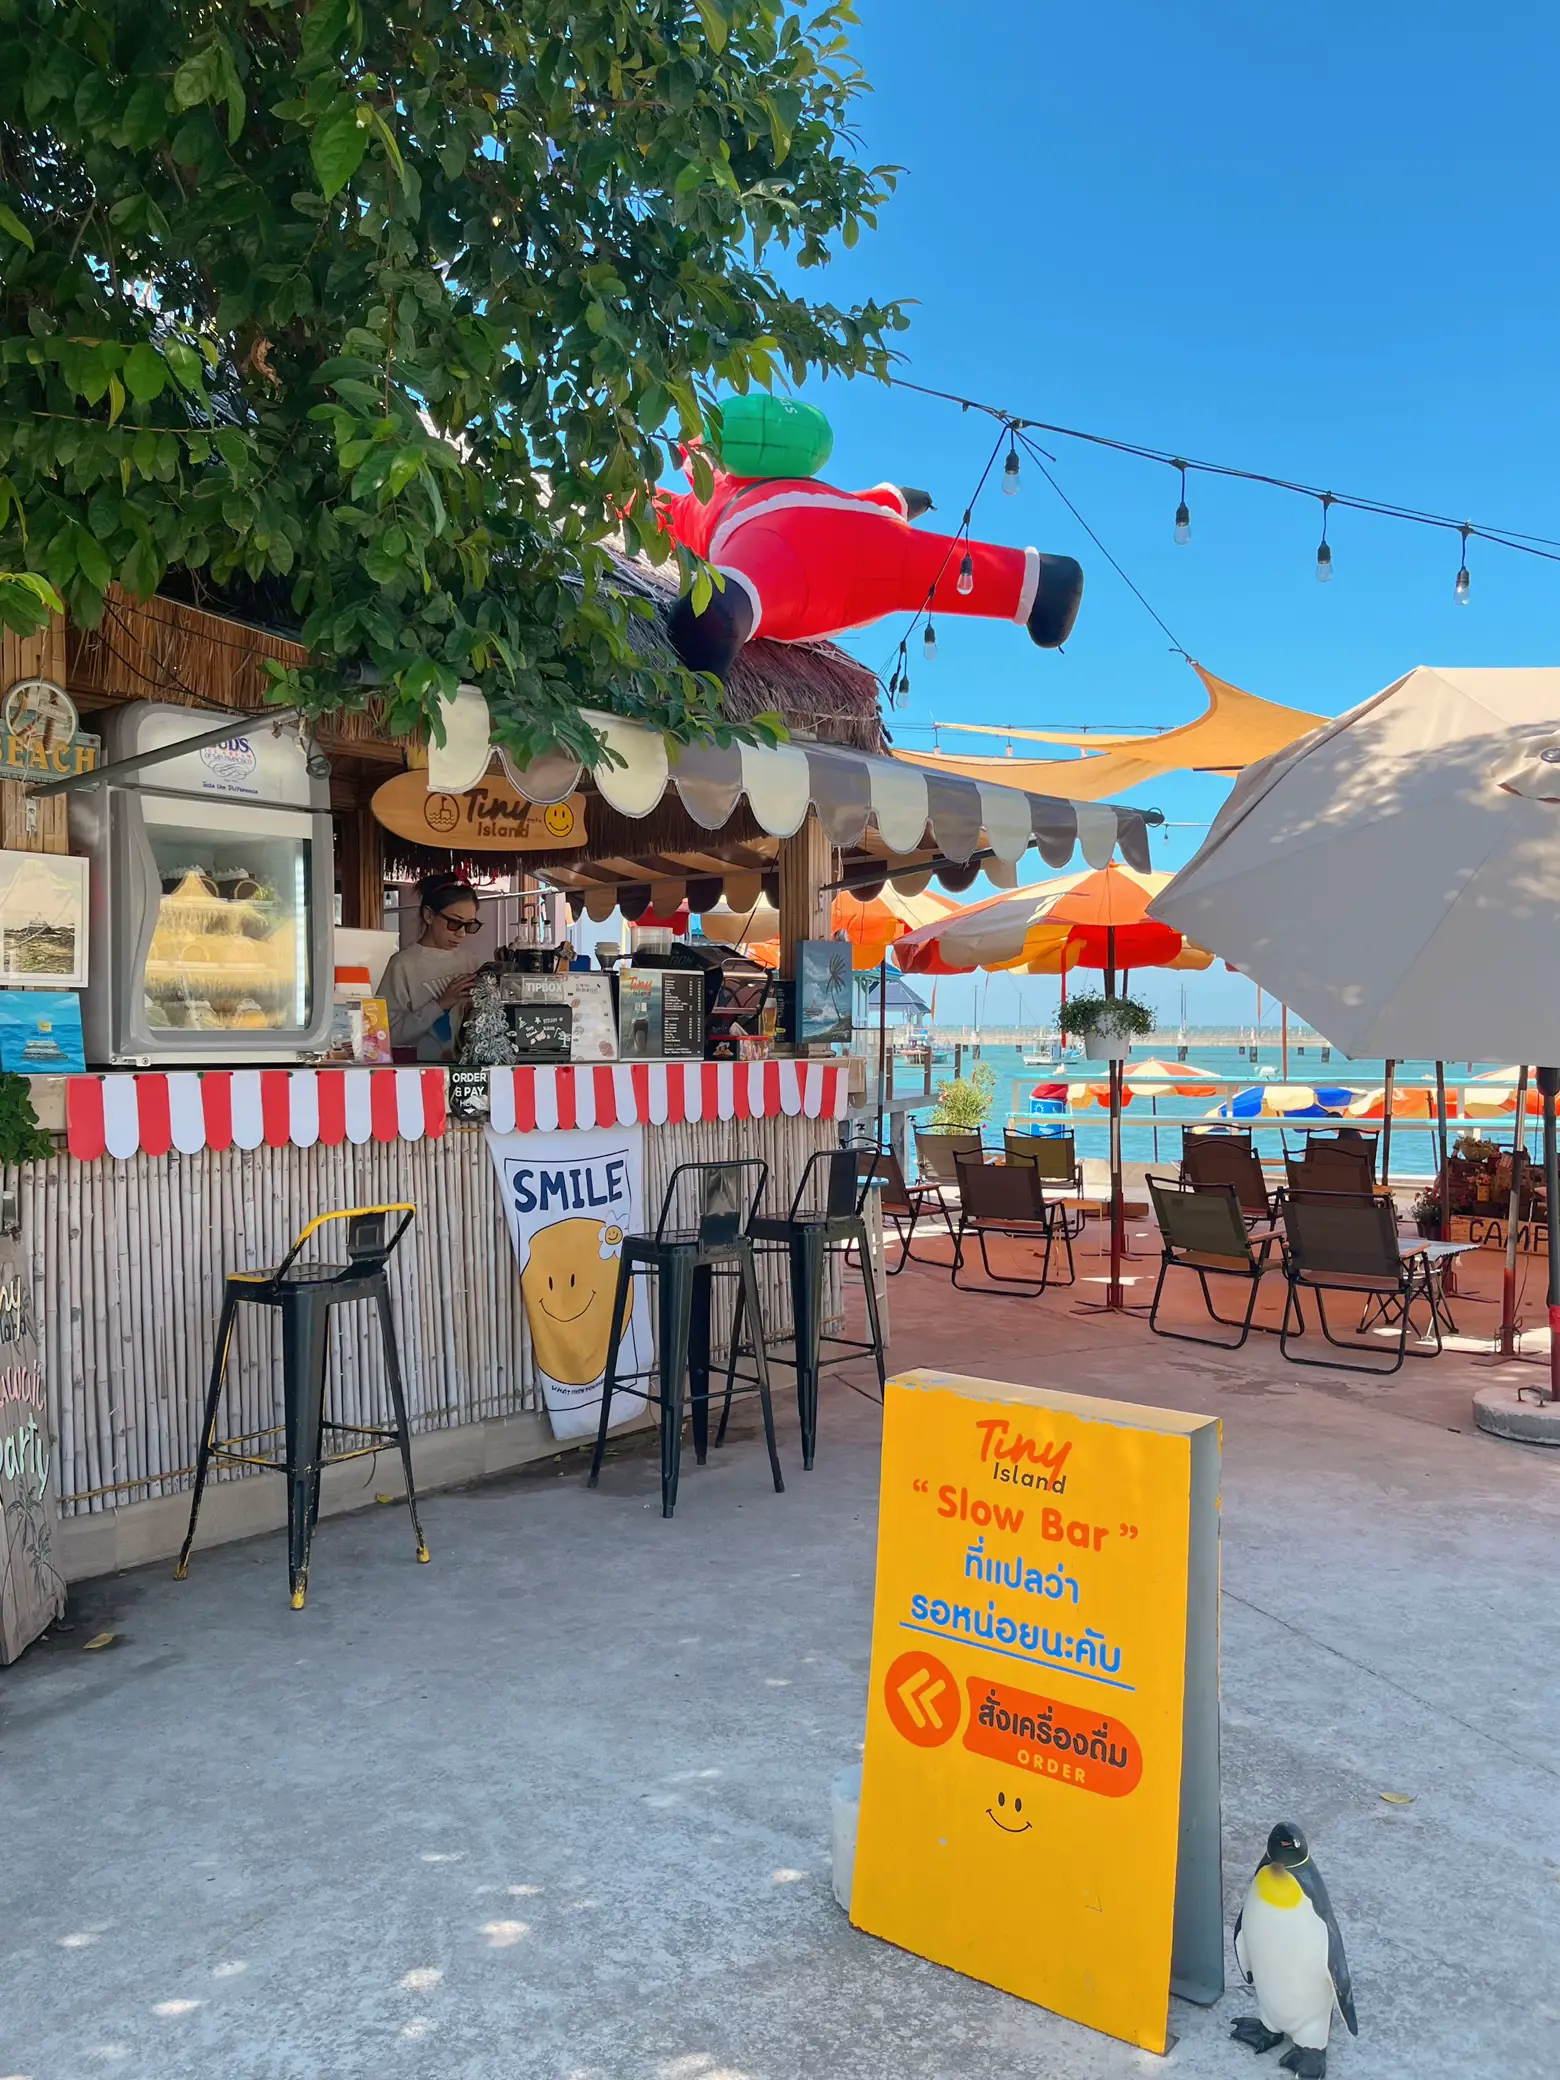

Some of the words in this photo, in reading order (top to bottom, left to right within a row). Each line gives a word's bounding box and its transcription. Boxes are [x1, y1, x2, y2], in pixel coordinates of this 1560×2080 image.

[0, 735, 96, 775] EACH
[463, 788, 532, 828] Tiny
[478, 822, 529, 838] Island
[525, 982, 563, 993] TIPBOX
[629, 976, 652, 992] Tiny
[452, 1072, 487, 1083] ORDER
[455, 1086, 462, 1097] &
[464, 1086, 485, 1097] PAY
[513, 1160, 624, 1213] SMILE
[0, 1412, 49, 1501] arty
[976, 1419, 1072, 1491] Tiny
[993, 1462, 1066, 1494] Island
[965, 1536, 1079, 1604] ที่แปลว่า
[911, 1594, 1121, 1673] รอหน่อยนะคับ
[977, 1689, 1127, 1768] สั่งเครื่องดื่ม
[1016, 1749, 1086, 1784] ORDER
